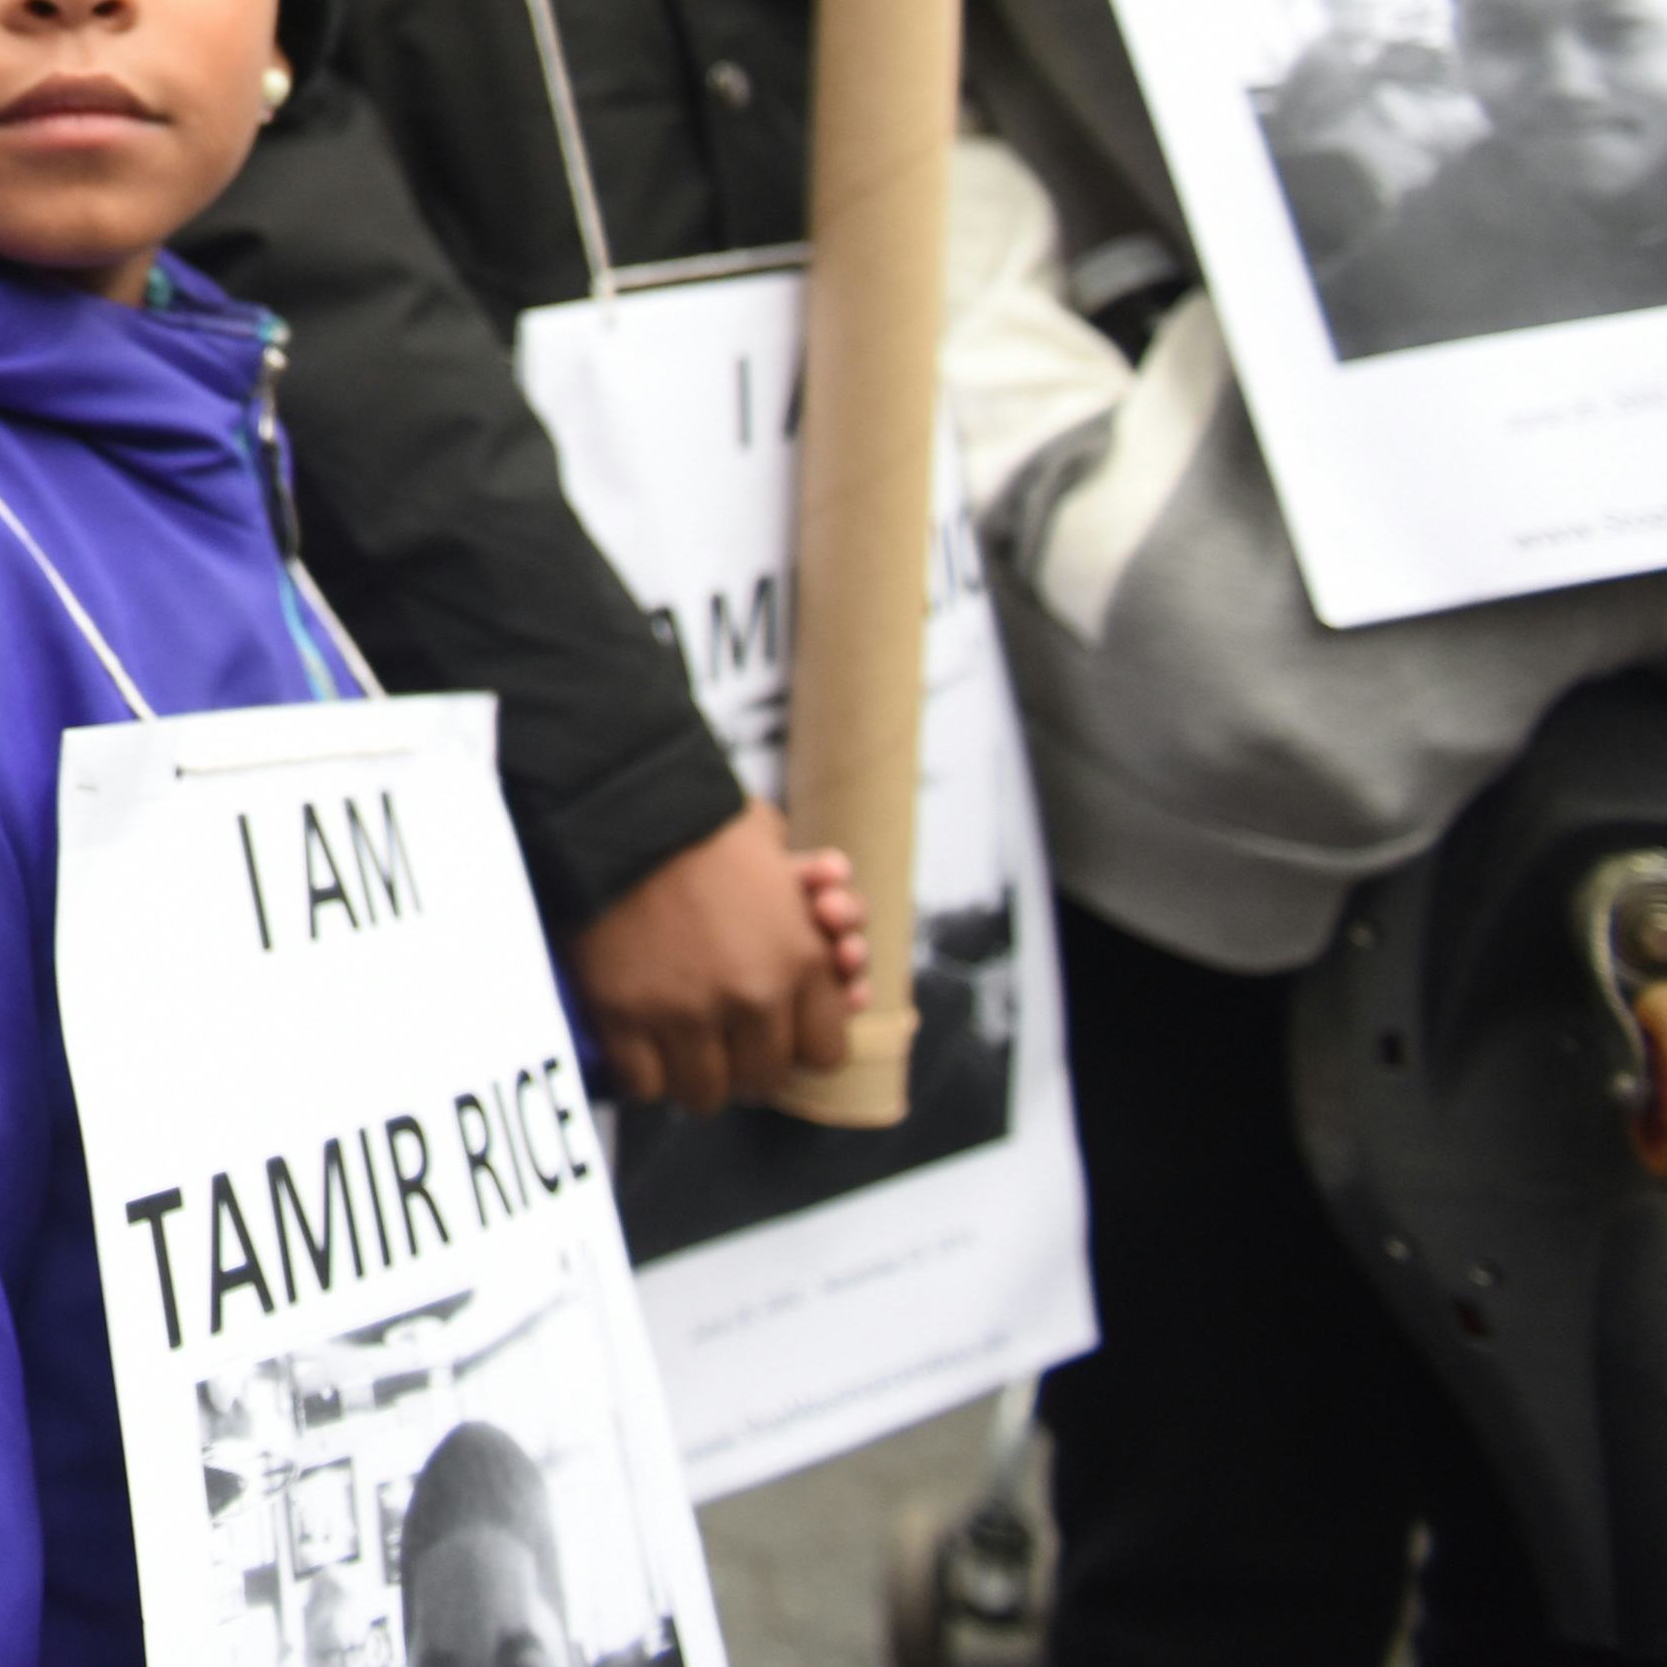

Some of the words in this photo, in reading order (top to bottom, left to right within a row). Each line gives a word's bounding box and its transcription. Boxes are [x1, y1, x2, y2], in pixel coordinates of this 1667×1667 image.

[237, 813, 272, 952] I
[301, 789, 424, 941] AM
[125, 1114, 451, 1351] TAMIR
[452, 1057, 591, 1229] RICE
